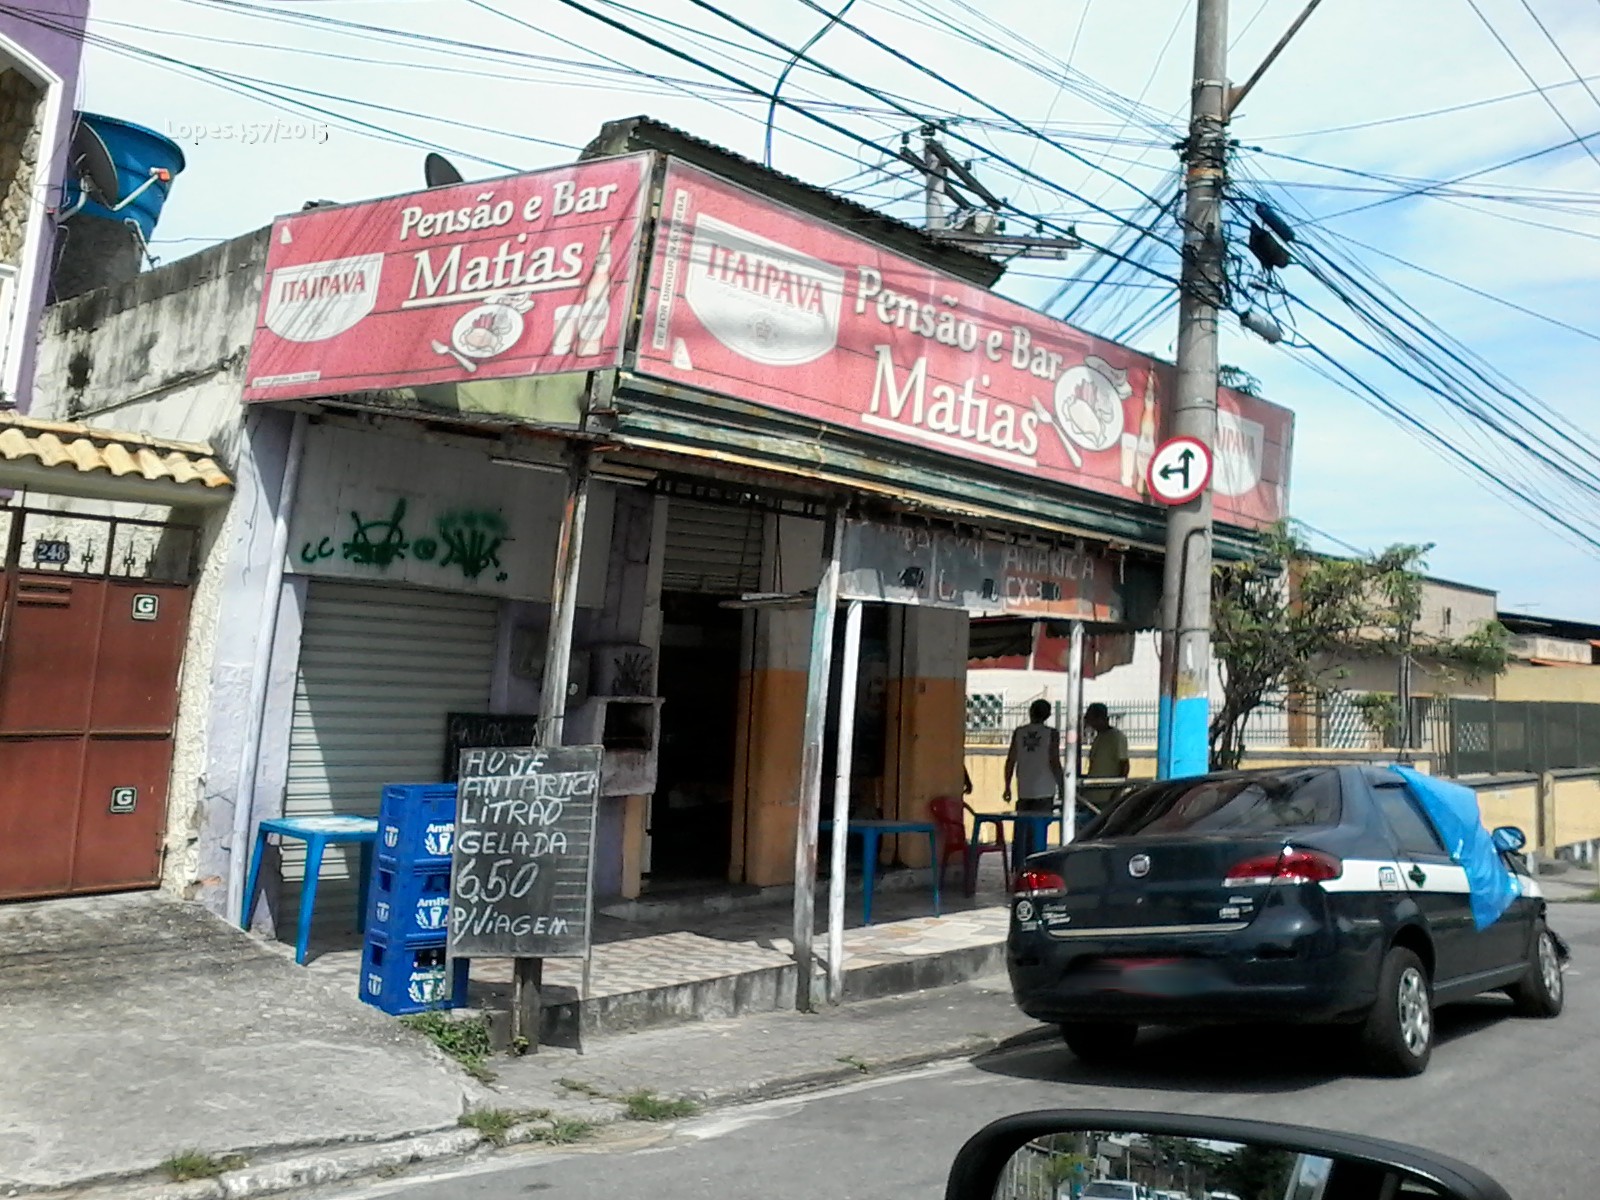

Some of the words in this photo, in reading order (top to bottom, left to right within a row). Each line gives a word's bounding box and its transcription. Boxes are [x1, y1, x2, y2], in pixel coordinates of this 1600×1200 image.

[400, 191, 515, 241] Pensão
[523, 195, 543, 222] e
[553, 180, 619, 217] Bar
[409, 232, 585, 300] Matias
[706, 243, 825, 317] ITAIPAVA
[281, 269, 367, 304] ITAIPAVA
[855, 264, 978, 352] Pensão
[986, 330, 1003, 362] e
[1011, 325, 1064, 380] Bar
[870, 344, 1039, 456] Matias
[38, 543, 66, 560] 248
[138, 598, 154, 613] G
[466, 751, 549, 777] HOJE
[117, 790, 132, 805] G
[426, 823, 455, 833] AmB
[458, 830, 567, 858] GELADA
